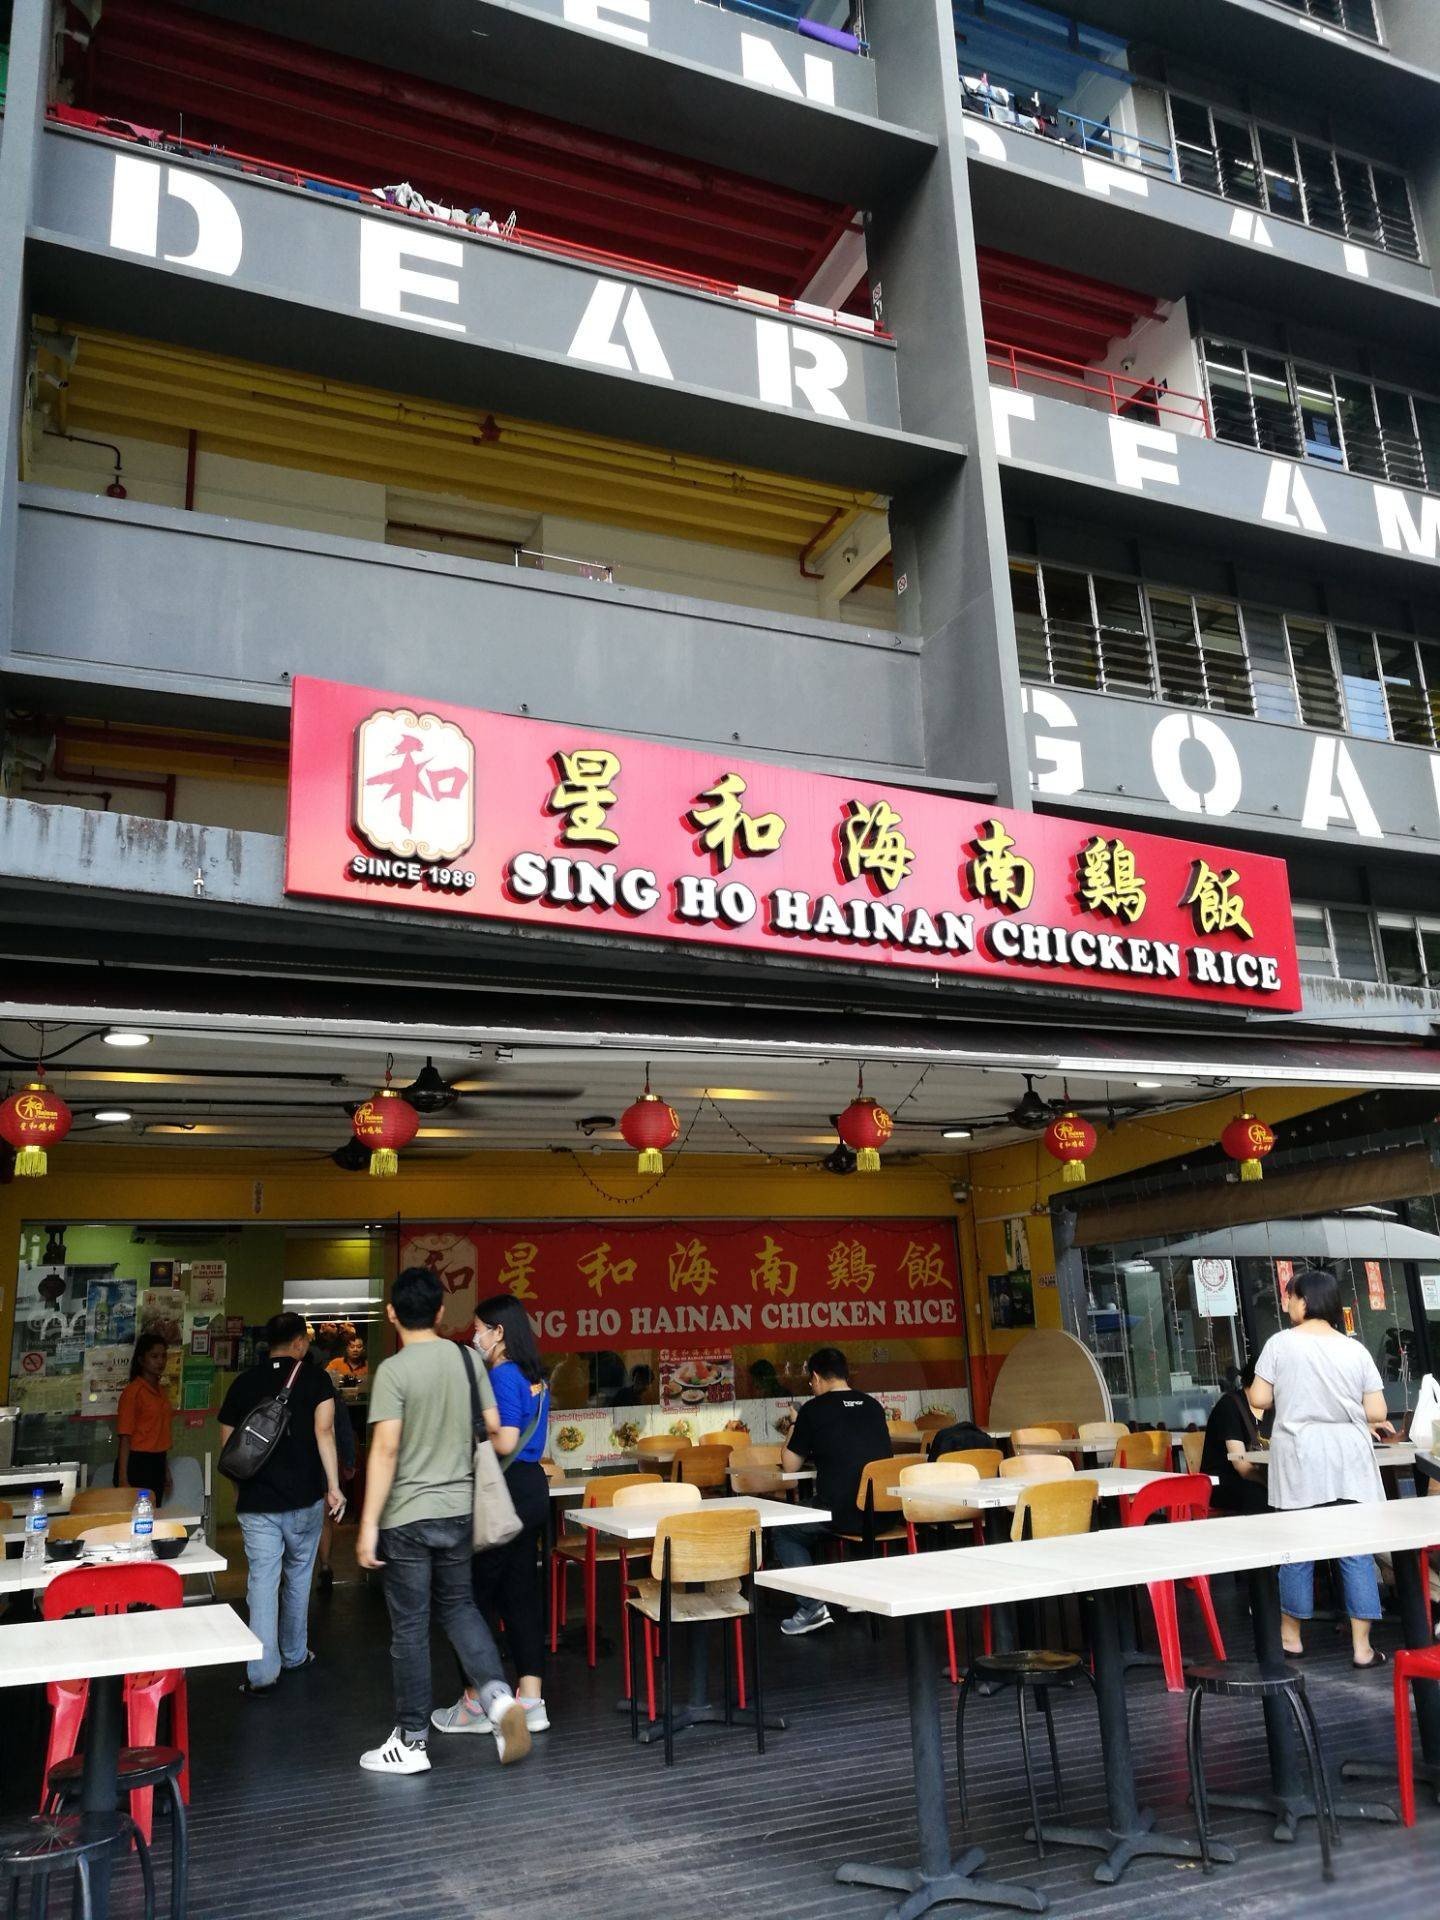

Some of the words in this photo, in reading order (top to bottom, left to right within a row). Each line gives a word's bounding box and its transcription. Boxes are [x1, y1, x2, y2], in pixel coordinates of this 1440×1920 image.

[109, 154, 852, 420] DEAR
[366, 733, 469, 834] 和
[1021, 686, 1440, 840] GOA
[352, 856, 421, 881] SINCE
[429, 866, 476, 888] 1989
[512, 852, 661, 911] SING
[679, 875, 757, 924] HO
[774, 888, 975, 951] HAINAN
[992, 919, 1180, 978] CHICKEN
[1193, 946, 1282, 991] RICE
[576, 1307, 621, 1337] HO
[630, 1303, 753, 1336] HAINAN
[761, 1300, 887, 1330] CHICKEN
[894, 1298, 957, 1326] RICE
